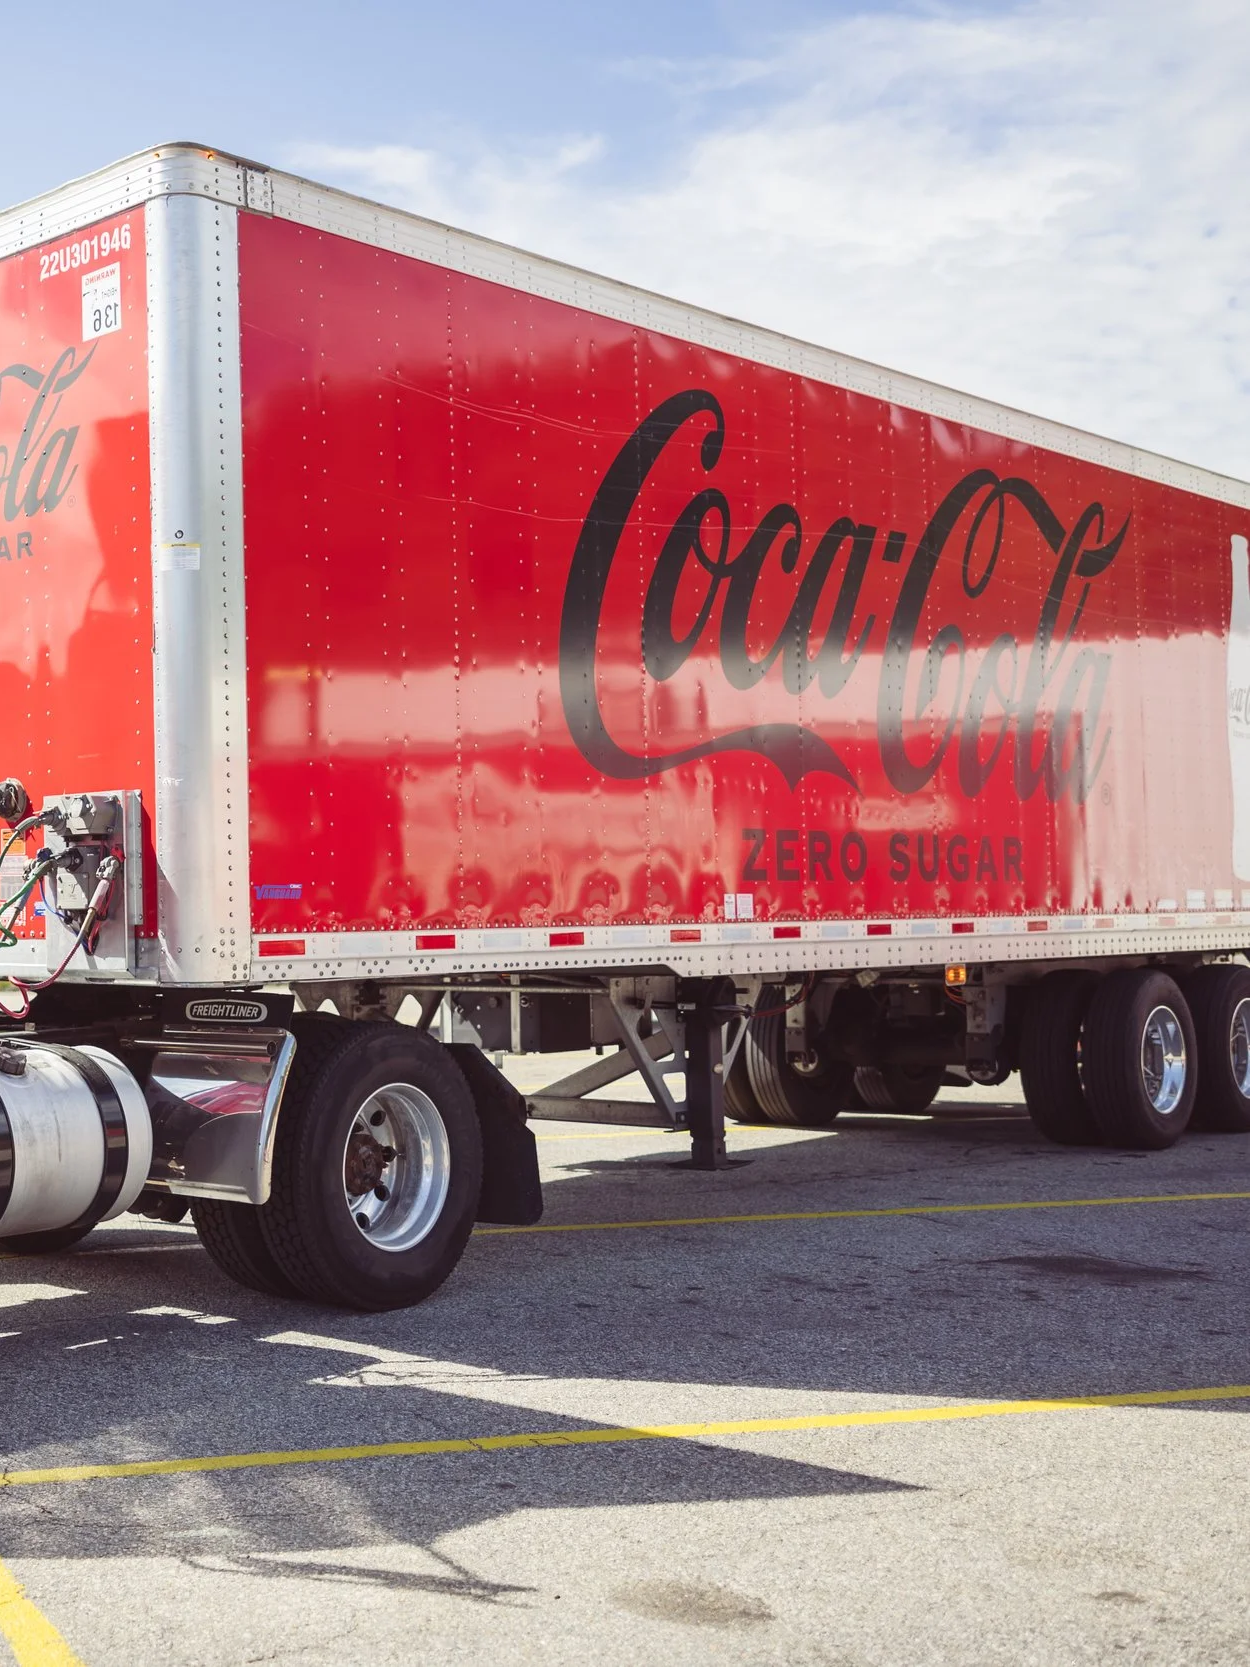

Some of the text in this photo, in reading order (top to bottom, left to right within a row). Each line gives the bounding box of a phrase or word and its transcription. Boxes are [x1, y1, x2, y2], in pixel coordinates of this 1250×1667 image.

[40, 224, 131, 282] 22U301946
[559, 389, 1132, 804] Coca-Cola
[742, 828, 1024, 884] ZERO SUGAR
[192, 1004, 259, 1017] FREIGHTLINER
